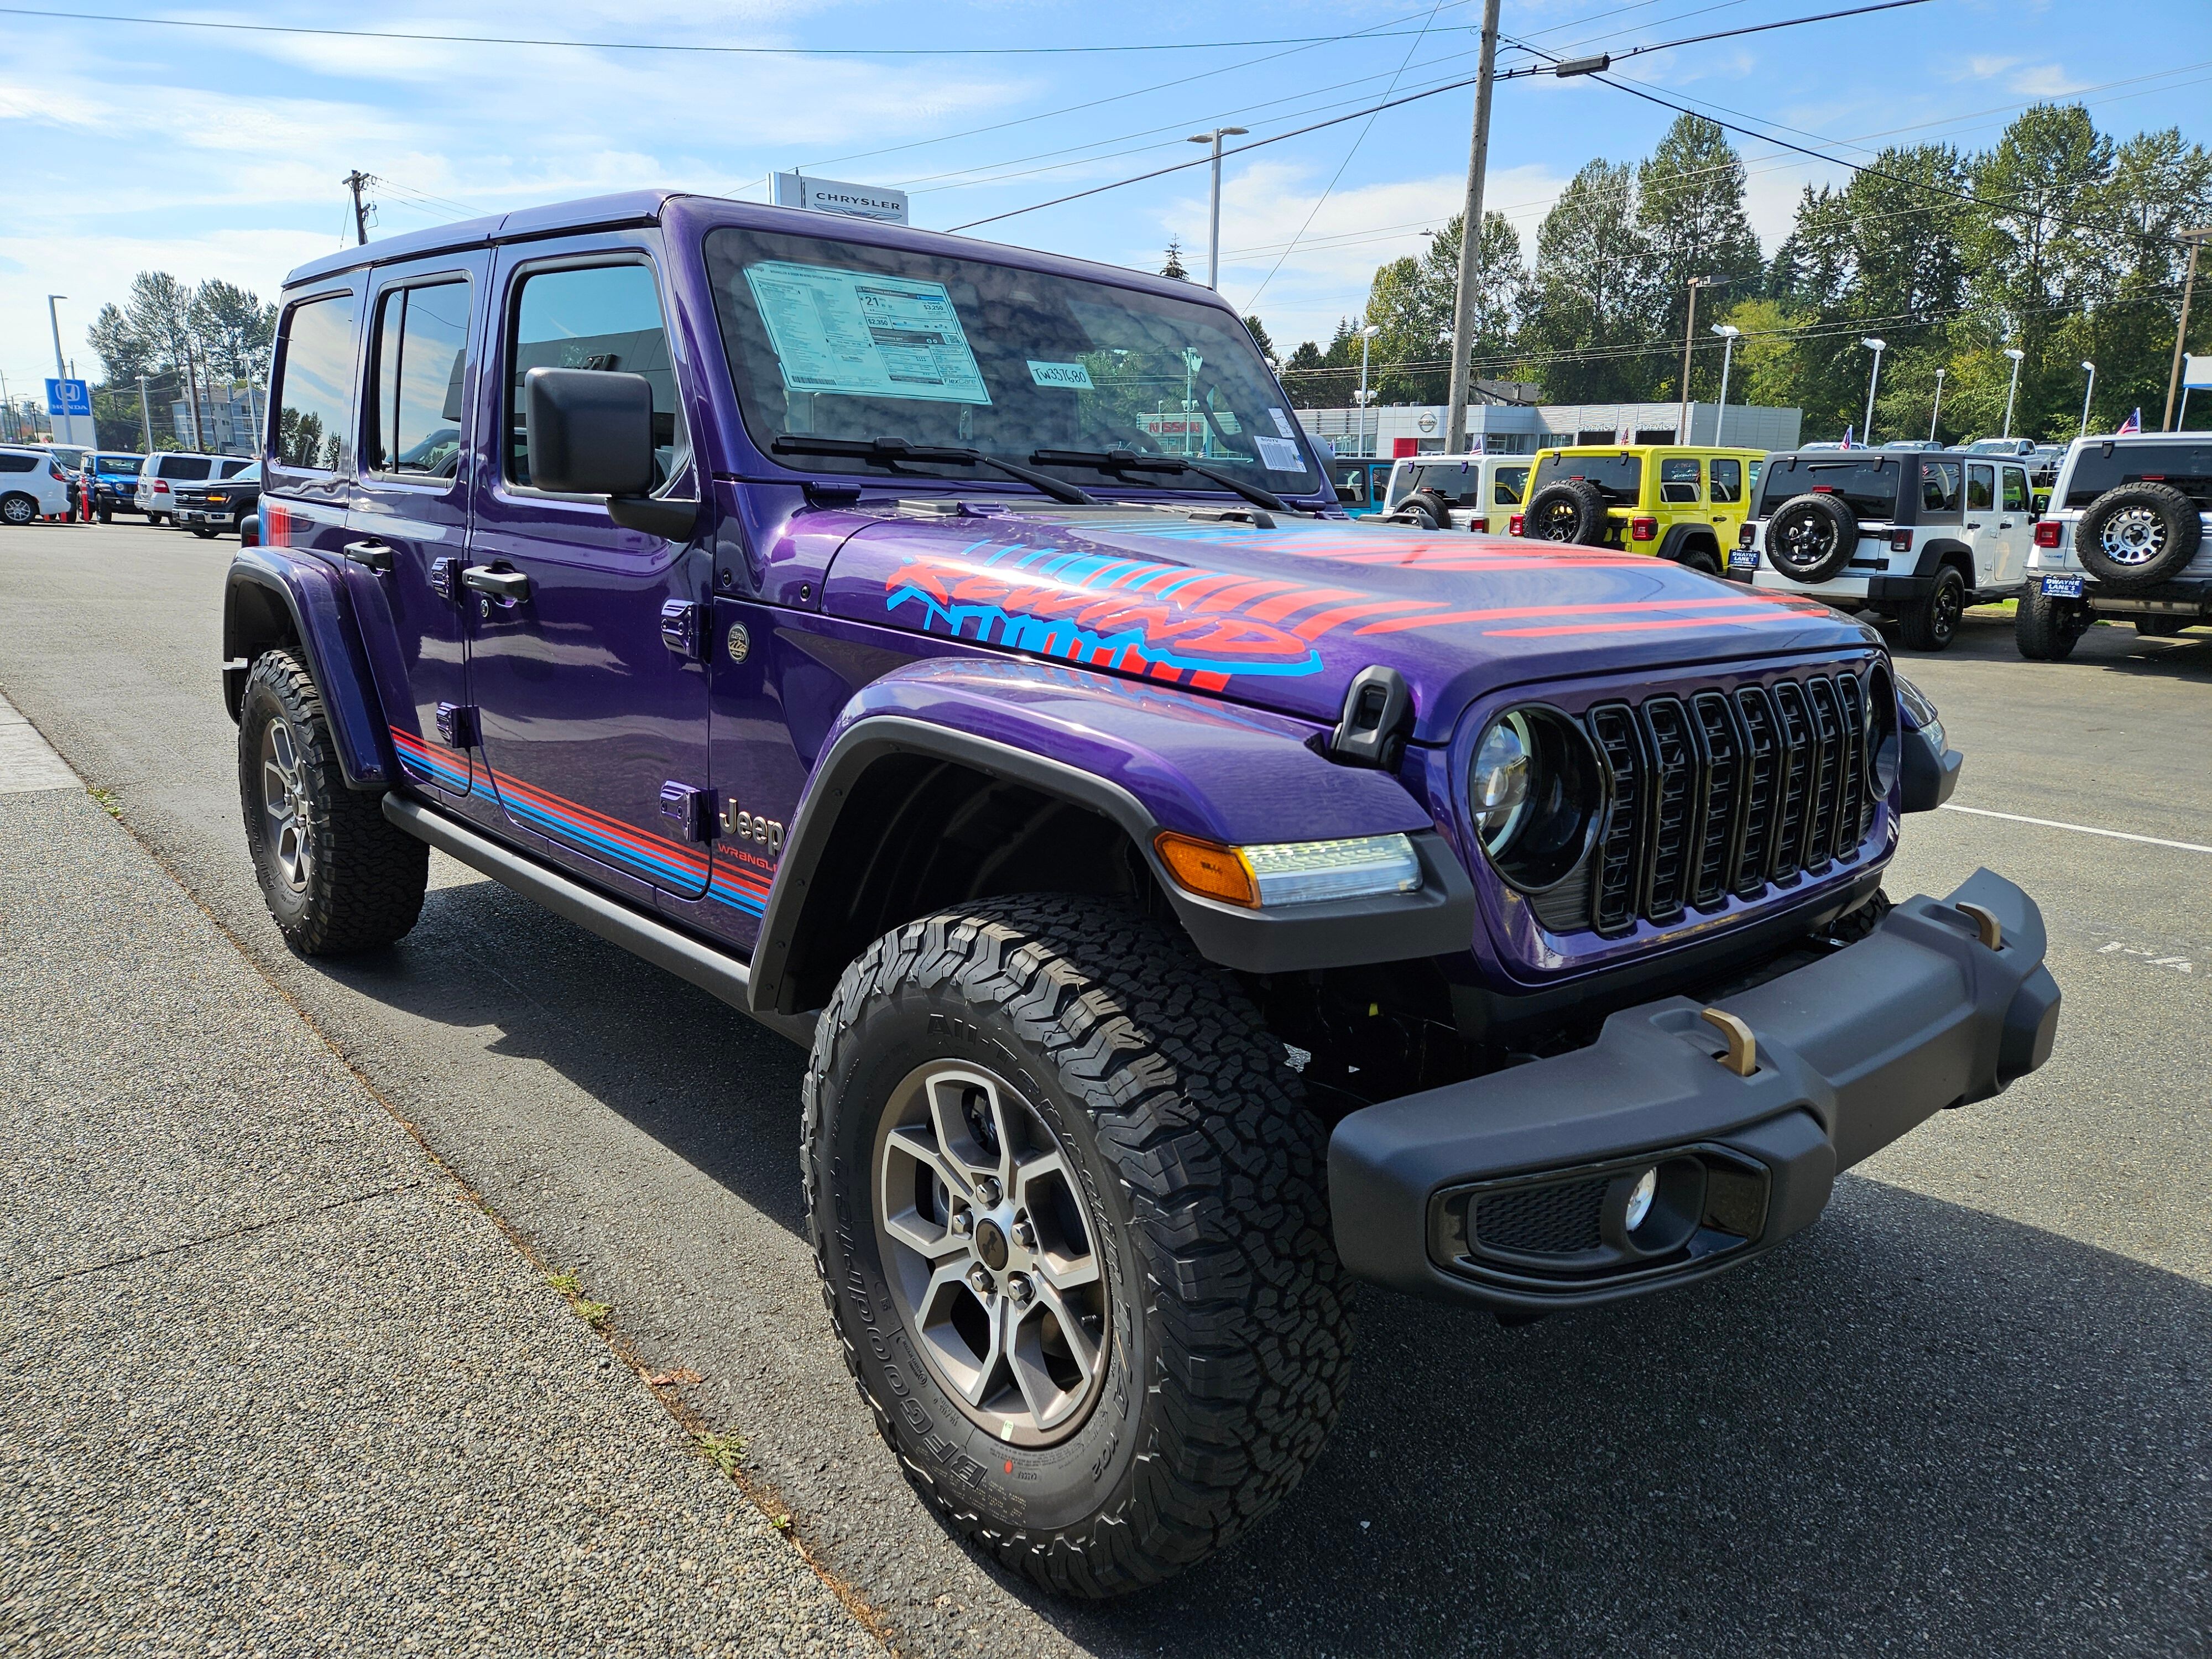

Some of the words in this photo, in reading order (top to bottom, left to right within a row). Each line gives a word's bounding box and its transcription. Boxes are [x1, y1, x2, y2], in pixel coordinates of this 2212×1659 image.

[816, 192, 900, 210] CHRYSLER
[865, 296, 879, 306] 21
[1032, 368, 1087, 383] TW337680
[1149, 422, 1199, 432] NSSAN
[885, 555, 1306, 655] REWIND
[719, 798, 785, 857] Jeep
